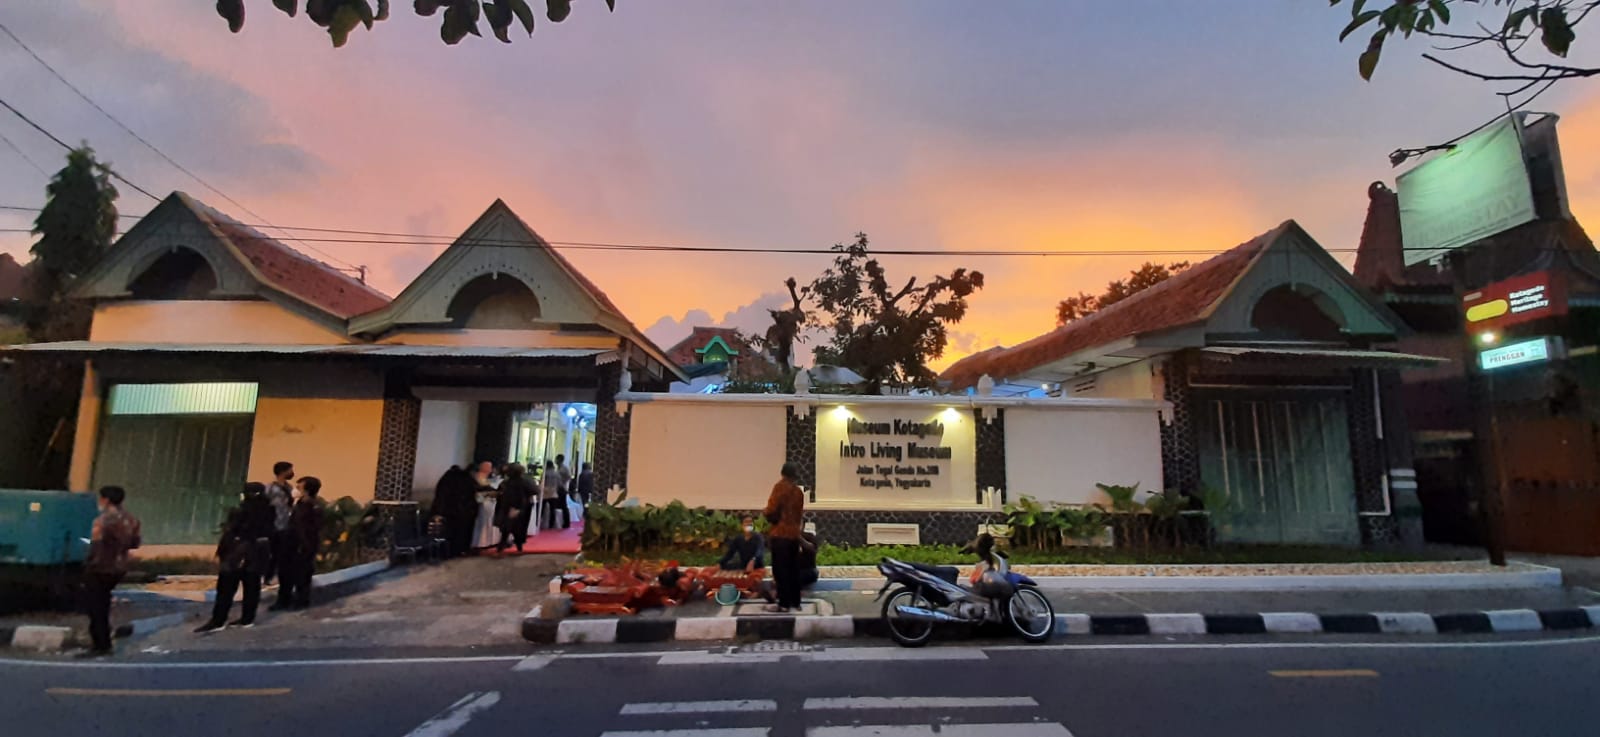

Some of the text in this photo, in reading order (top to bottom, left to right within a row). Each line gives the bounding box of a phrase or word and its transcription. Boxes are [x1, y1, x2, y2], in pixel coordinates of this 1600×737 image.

[847, 418, 890, 435] Museum
[840, 440, 952, 462] Intro Living Museum
[856, 465, 873, 474] Jalan
[895, 477, 931, 489] Yogyakarta
